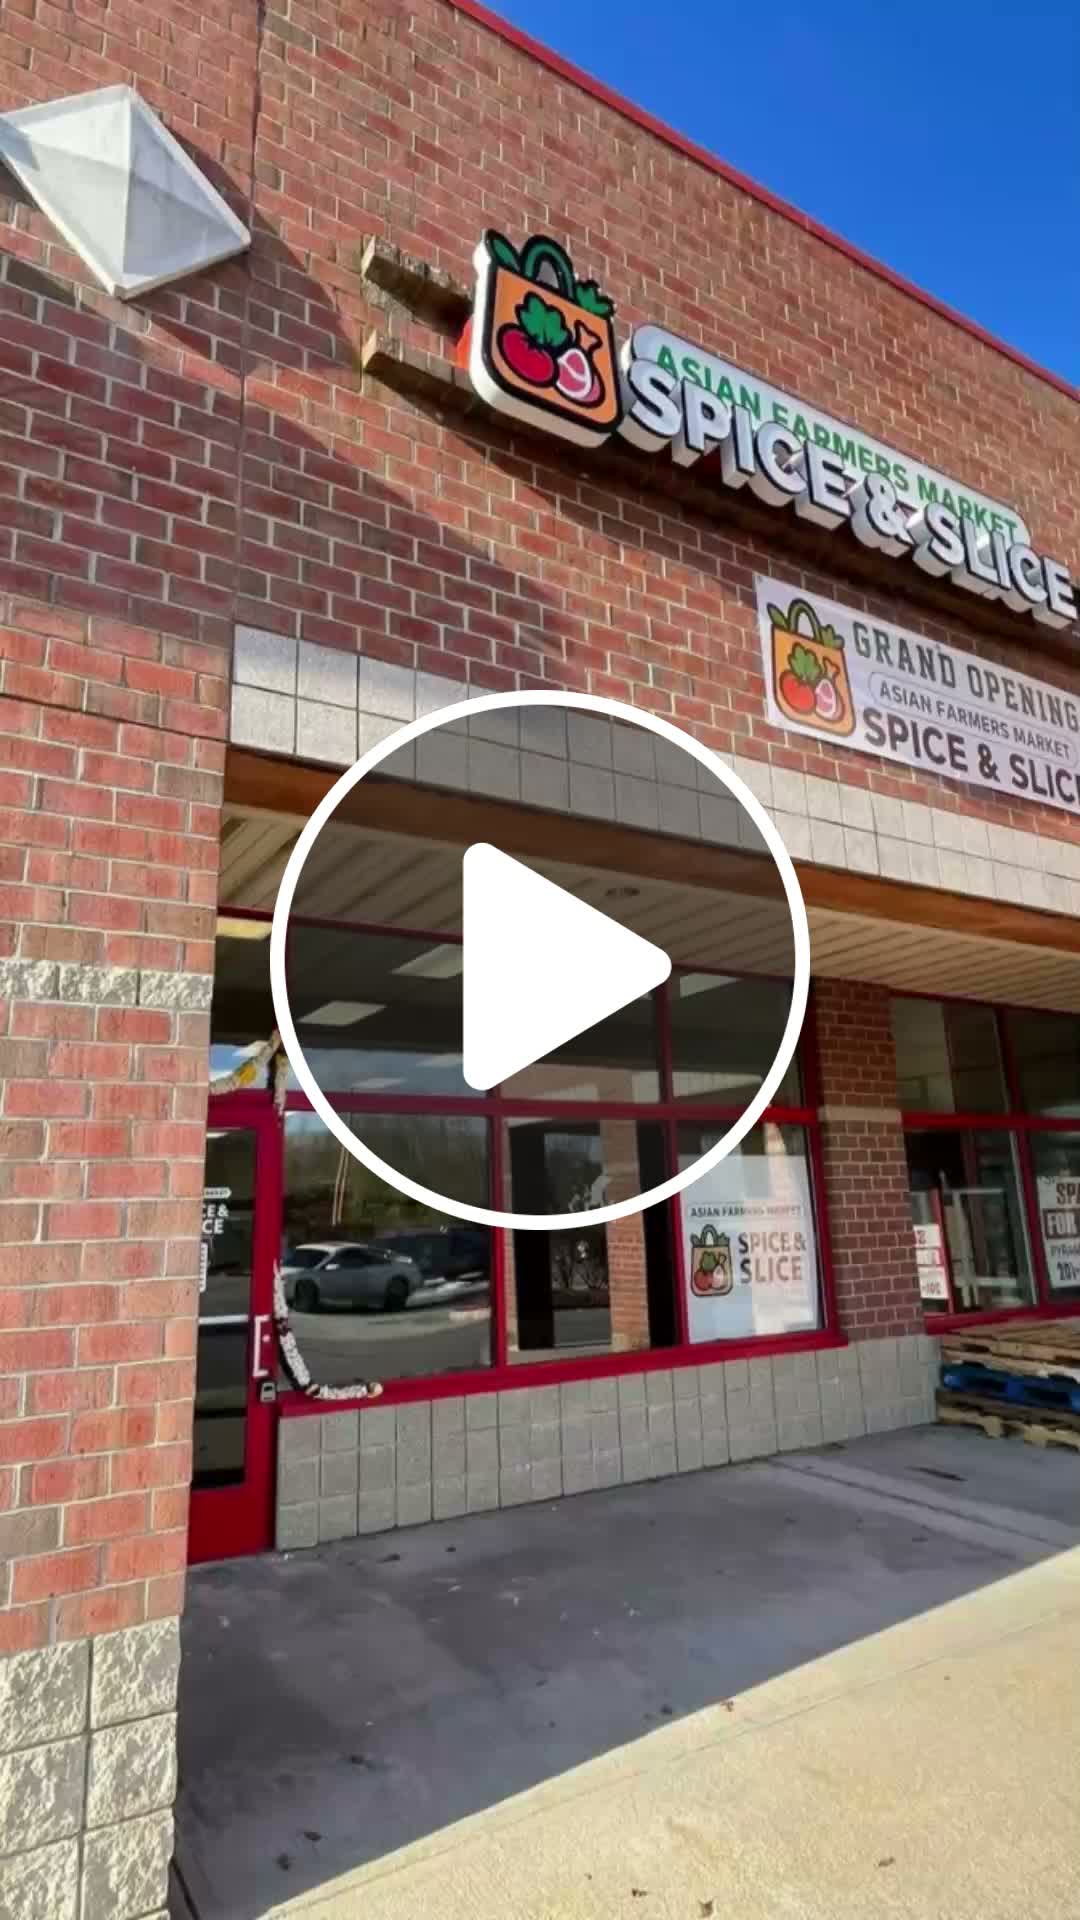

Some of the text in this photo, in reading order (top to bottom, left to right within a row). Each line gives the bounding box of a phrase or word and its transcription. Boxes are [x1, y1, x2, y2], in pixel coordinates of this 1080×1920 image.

[656, 344, 1018, 540] ASIAN FARMERS MARKET
[626, 358, 1080, 622] SPICE & SLICE
[852, 620, 1080, 733] GRAND OPENING
[862, 707, 969, 772] SPICE
[977, 743, 1001, 783] &
[879, 681, 1071, 762] ASIAN FARMERS MARKET
[690, 1206, 720, 1219] ASIAN
[738, 1231, 791, 1255] SPICE
[1047, 1212, 1077, 1236] FOR
[740, 1255, 803, 1284] SLICE
